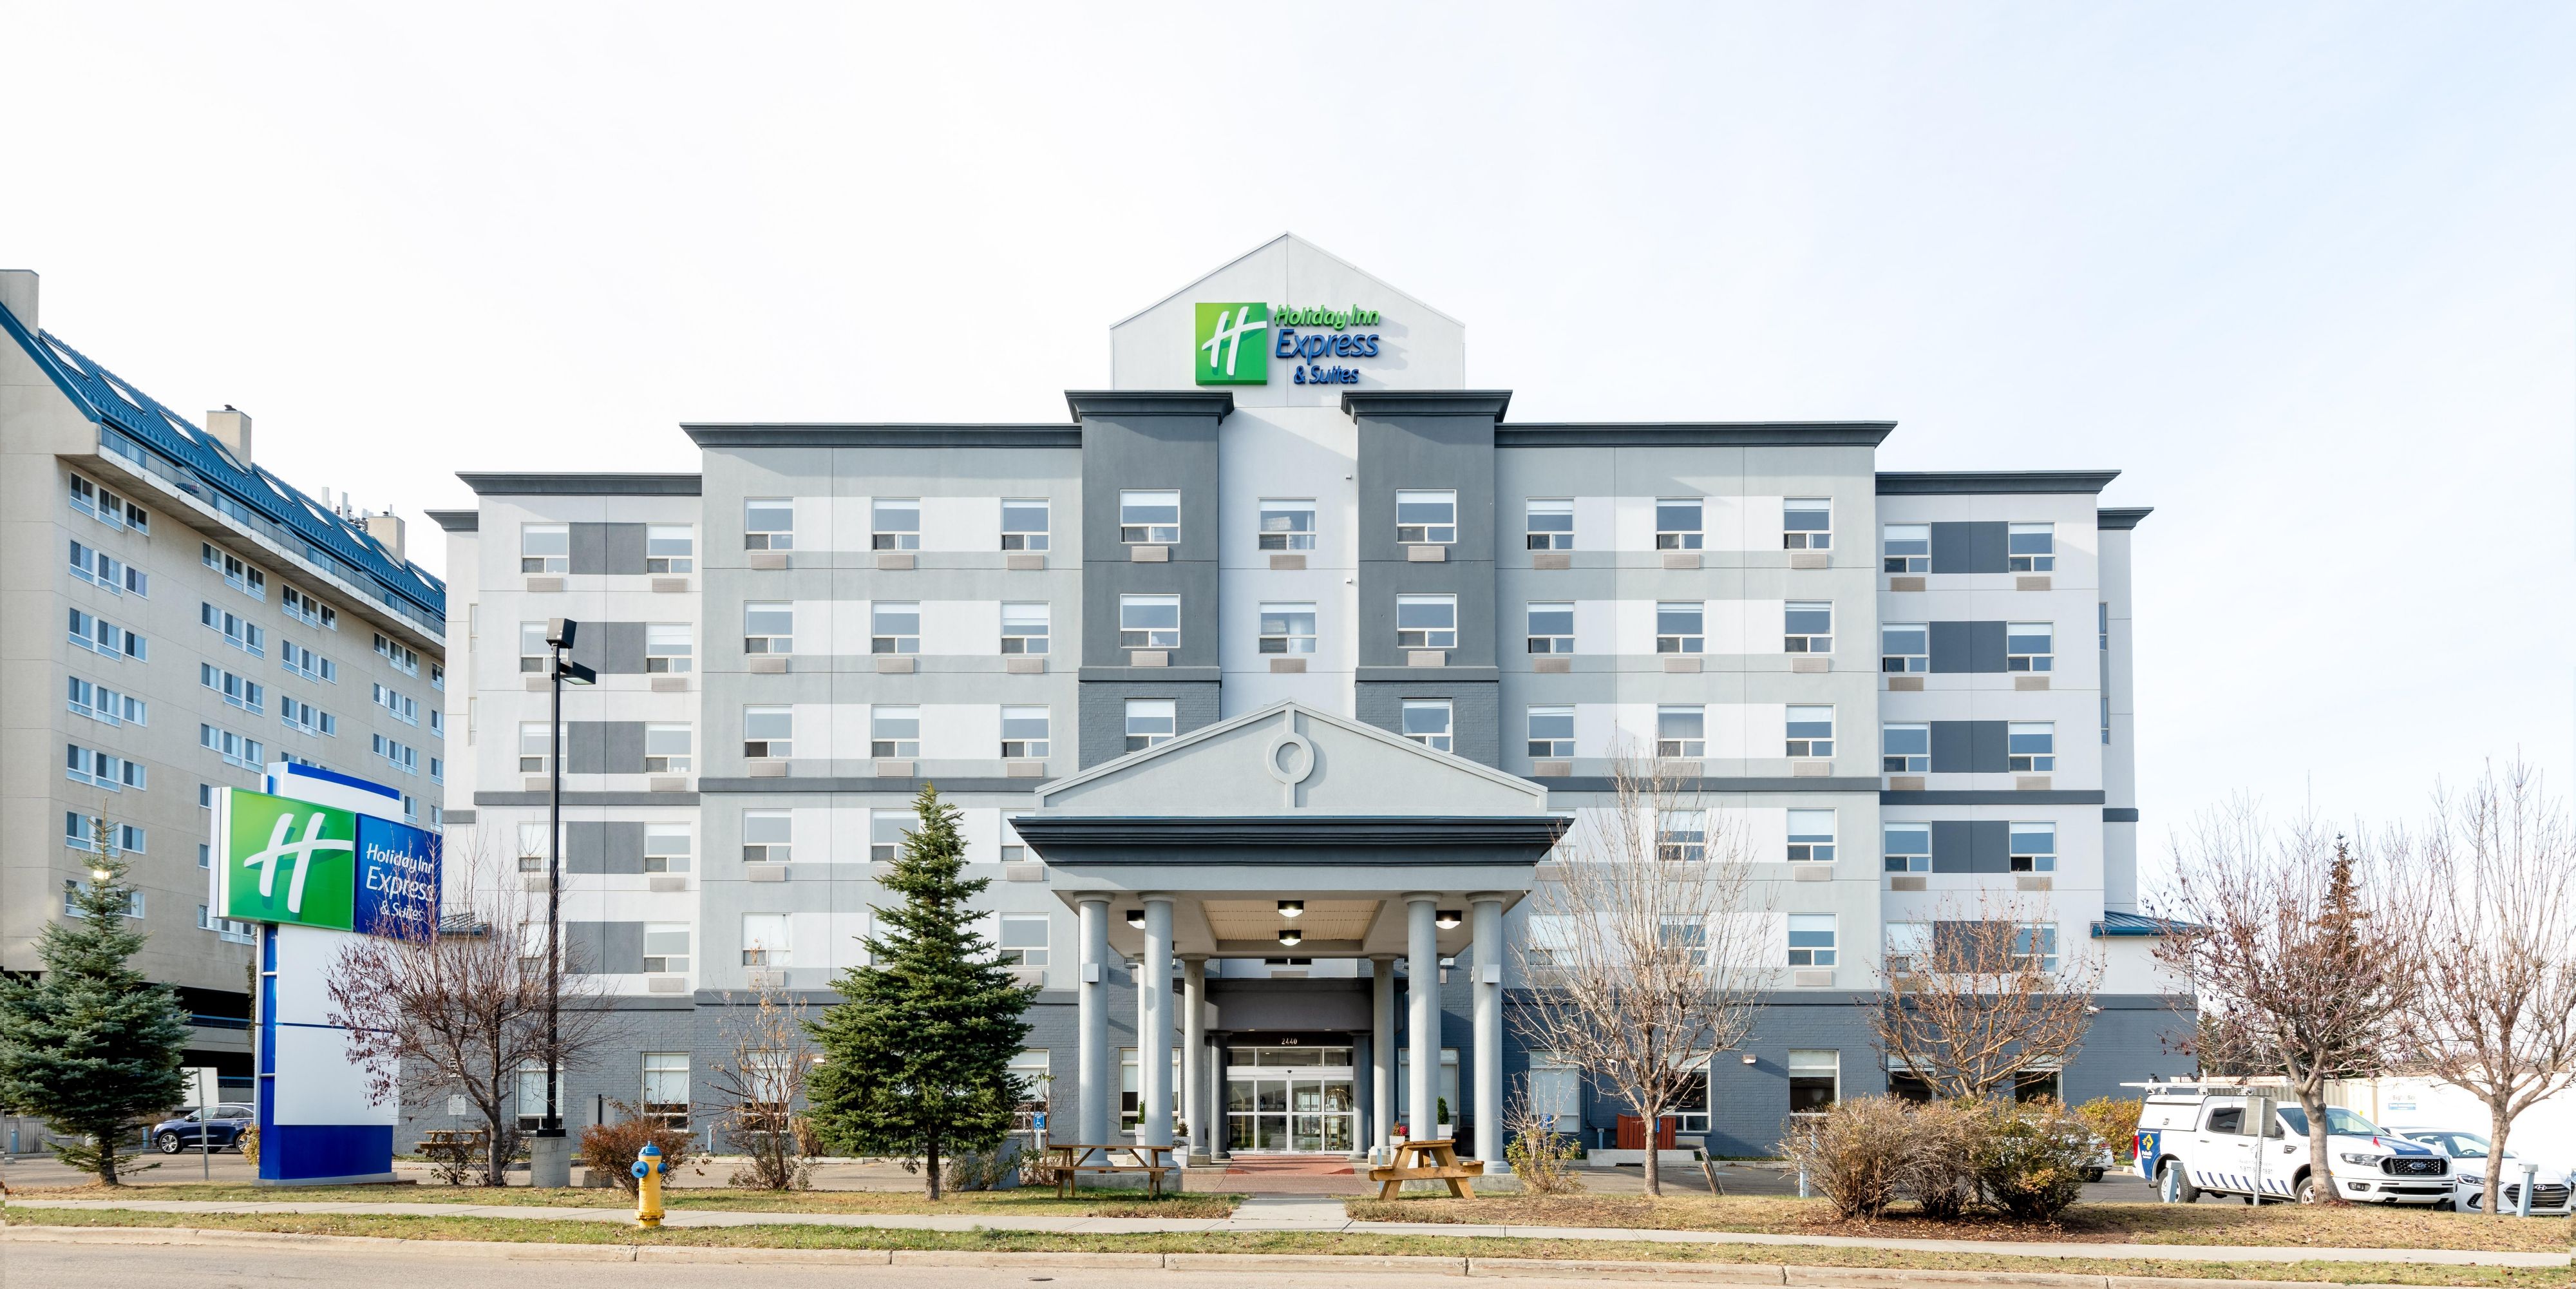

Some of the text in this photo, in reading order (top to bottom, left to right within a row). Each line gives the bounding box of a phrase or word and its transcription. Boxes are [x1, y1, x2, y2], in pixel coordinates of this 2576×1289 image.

[1274, 304, 1379, 330] Holiday Inn
[1276, 329, 1379, 365] Express
[1294, 365, 1359, 384] & Suites
[366, 843, 417, 874] Holiday
[366, 865, 436, 902] Express
[381, 901, 424, 921] & Suites
